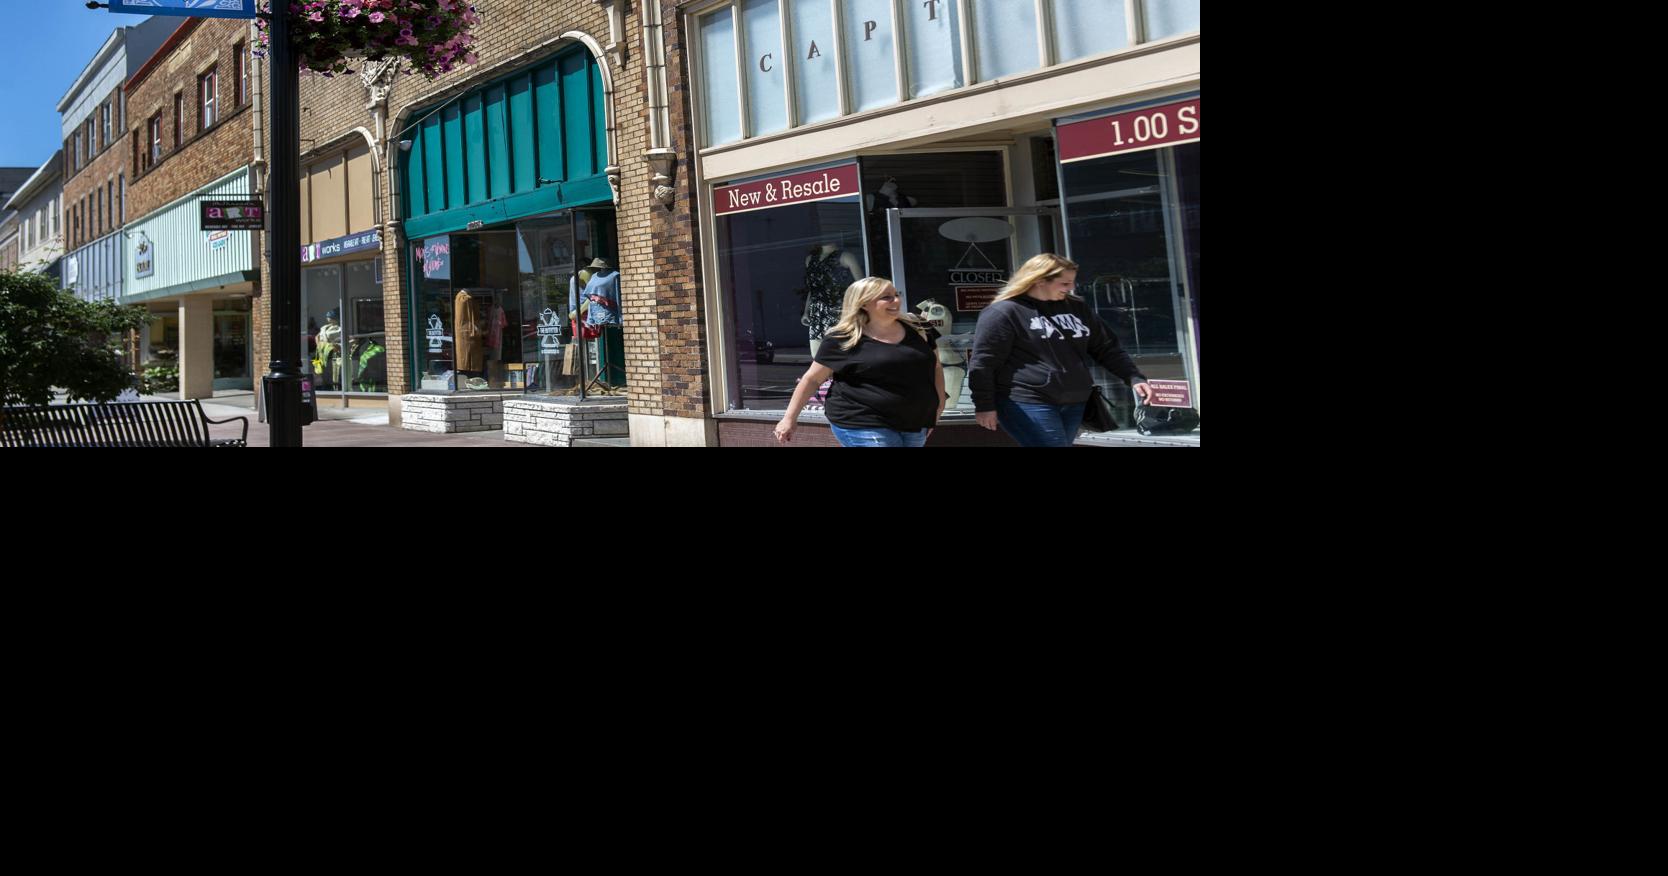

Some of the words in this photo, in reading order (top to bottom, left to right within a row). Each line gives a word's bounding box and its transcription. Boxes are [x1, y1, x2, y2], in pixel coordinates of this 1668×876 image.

[1111, 111, 1168, 146] 1.00
[728, 188, 761, 208] New
[765, 183, 777, 202] &
[780, 173, 841, 200] Resale
[321, 242, 340, 255] works
[950, 271, 1003, 283] CLOSED
